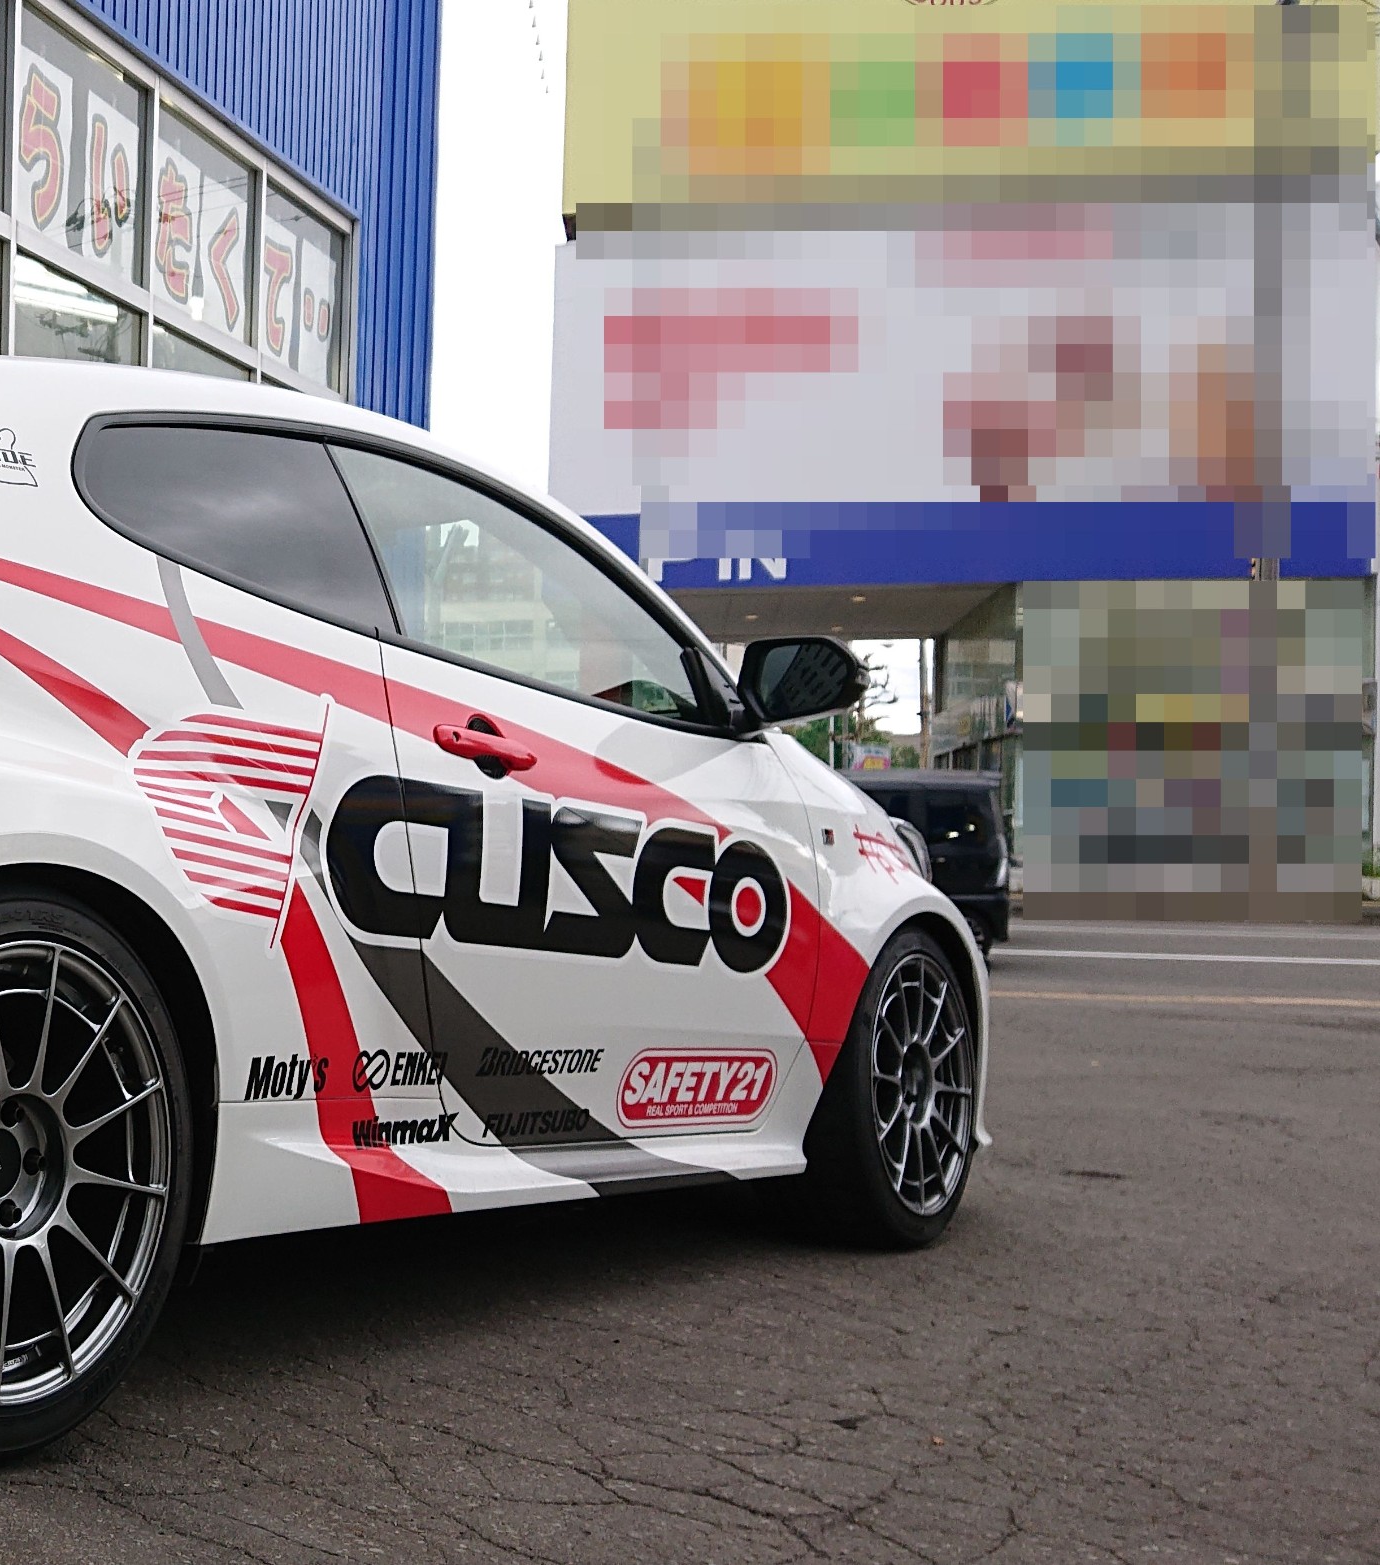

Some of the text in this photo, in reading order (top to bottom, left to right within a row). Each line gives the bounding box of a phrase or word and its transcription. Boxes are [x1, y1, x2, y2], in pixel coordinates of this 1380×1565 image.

[326, 774, 789, 975] CUSCO
[244, 1054, 329, 1101] Moty's
[390, 1051, 449, 1087] ENKEI
[475, 1047, 605, 1077] BRIDGESTONE
[624, 1060, 771, 1106] SAFETY21
[482, 1108, 592, 1138] FUJITSUBO
[646, 1105, 664, 1117] REAL
[664, 1104, 688, 1116] SPORT
[693, 1102, 739, 1115] COMPETITION
